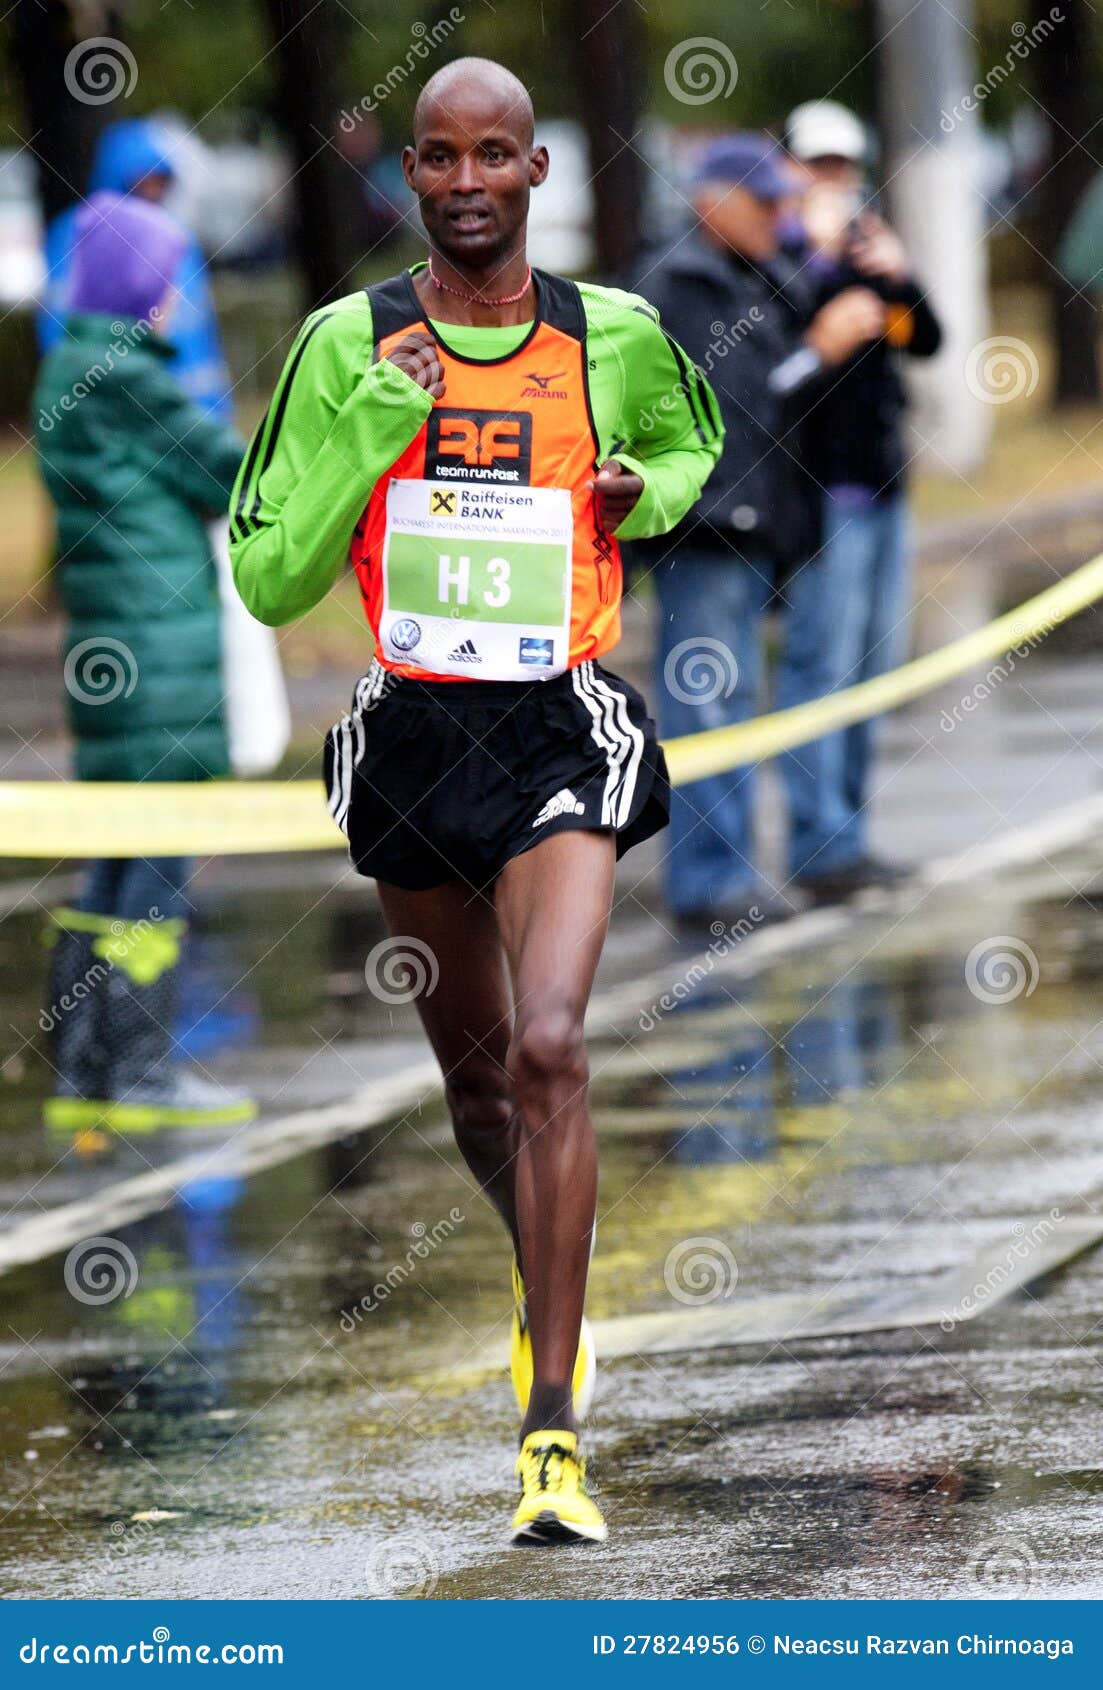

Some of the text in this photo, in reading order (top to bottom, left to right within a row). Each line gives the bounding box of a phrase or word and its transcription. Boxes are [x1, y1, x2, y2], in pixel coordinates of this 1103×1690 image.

[436, 465, 520, 481] team run-fast
[461, 490, 533, 506] Raiffeisen
[461, 506, 504, 520] BANK
[437, 521, 499, 534] INTERNATIONAL
[501, 526, 549, 537] MARATHON
[438, 554, 511, 608] H 3
